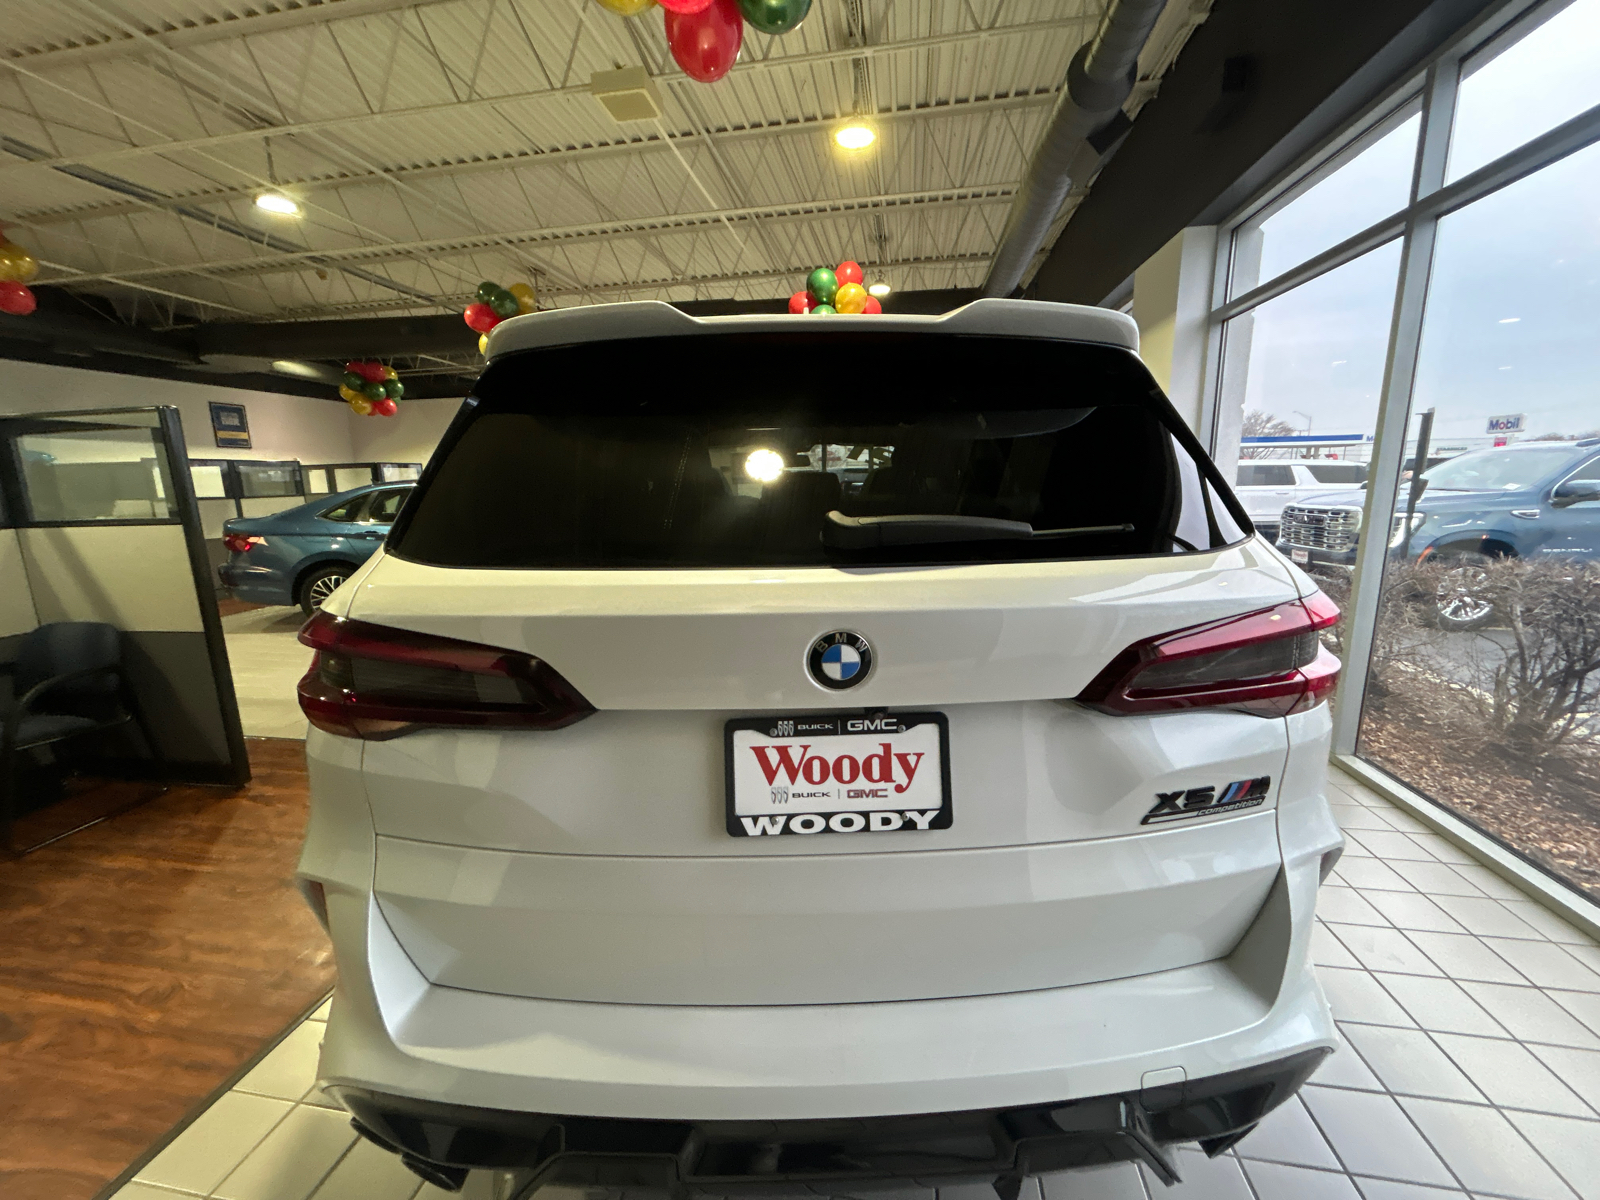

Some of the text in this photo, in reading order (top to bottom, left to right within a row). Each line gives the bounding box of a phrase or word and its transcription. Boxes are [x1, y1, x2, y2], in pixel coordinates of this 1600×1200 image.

[1489, 417, 1520, 430] Mobil
[815, 633, 868, 653] BMW
[797, 718, 898, 732] BUICK GMC
[750, 743, 925, 794] Woody
[791, 788, 888, 799] BUICK GMC
[740, 810, 940, 837] WOODY
